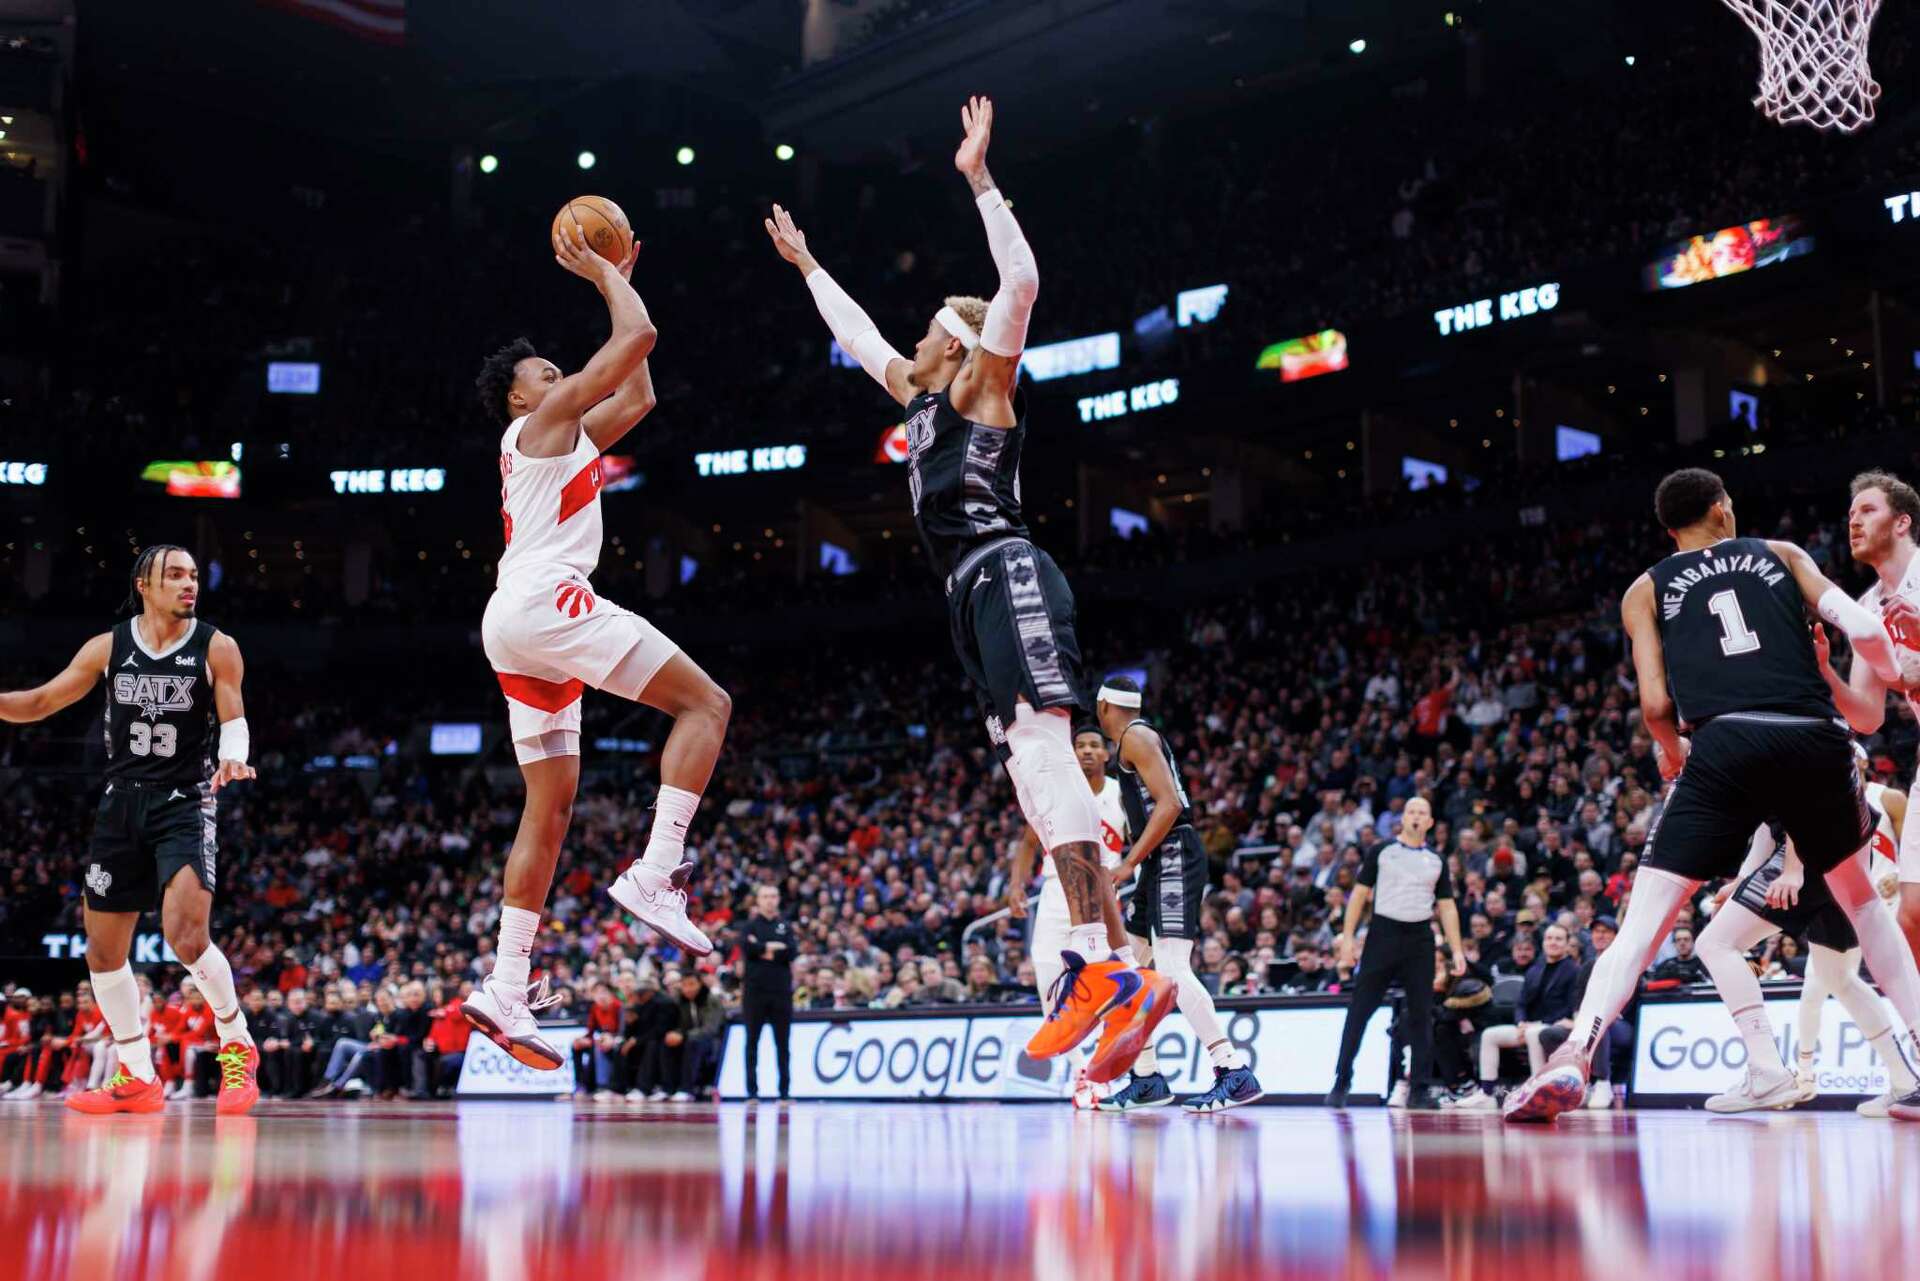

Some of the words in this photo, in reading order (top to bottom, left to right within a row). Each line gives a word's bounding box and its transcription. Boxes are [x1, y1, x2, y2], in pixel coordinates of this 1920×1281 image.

[1434, 299, 1493, 336] THE
[1500, 282, 1560, 320] KEG
[1078, 390, 1127, 422] THE
[1131, 379, 1179, 411] KEG
[330, 470, 385, 493] THE
[391, 468, 445, 492] KEG
[695, 450, 748, 476] THE
[753, 445, 806, 472] KEG
[1663, 554, 1785, 620] WEMBANYAMA
[1708, 589, 1761, 656] 1
[114, 673, 197, 712] SATX
[130, 721, 177, 757] 33
[813, 1020, 1001, 1097] Google
[1819, 1070, 1885, 1093] Google
